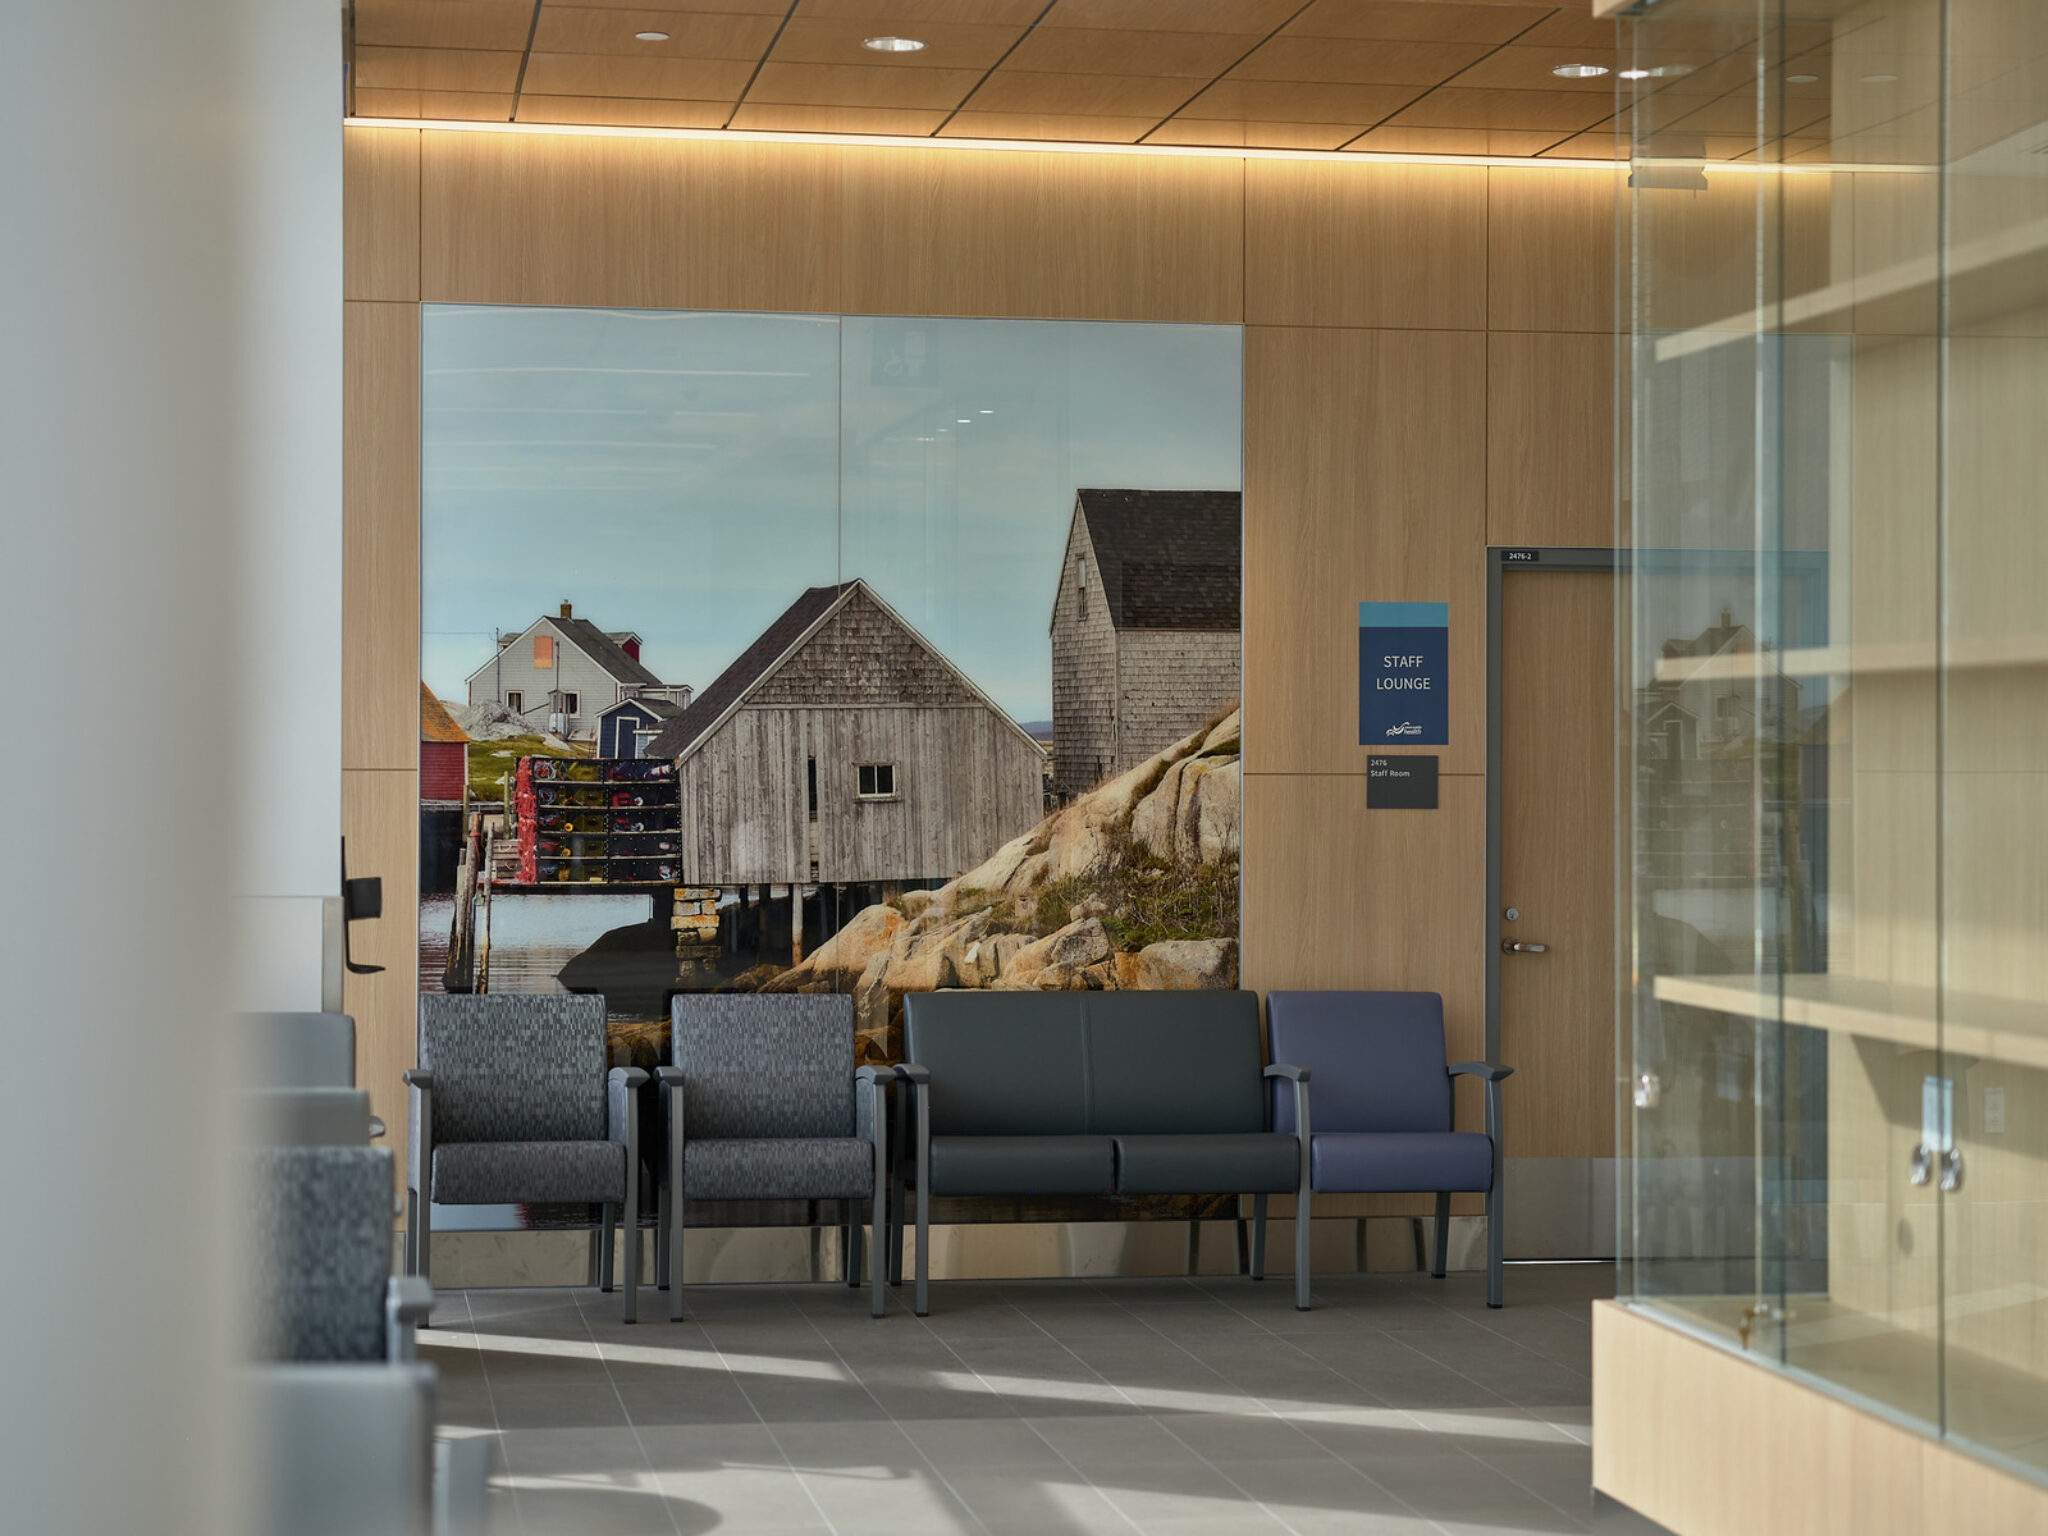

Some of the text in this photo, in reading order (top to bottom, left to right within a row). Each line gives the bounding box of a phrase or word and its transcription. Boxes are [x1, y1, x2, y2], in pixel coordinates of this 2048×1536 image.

[1509, 552, 1532, 560] 2476-2
[1383, 656, 1423, 668] STAFF
[1376, 678, 1430, 690] LOUNGE
[1370, 769, 1388, 777] Staff
